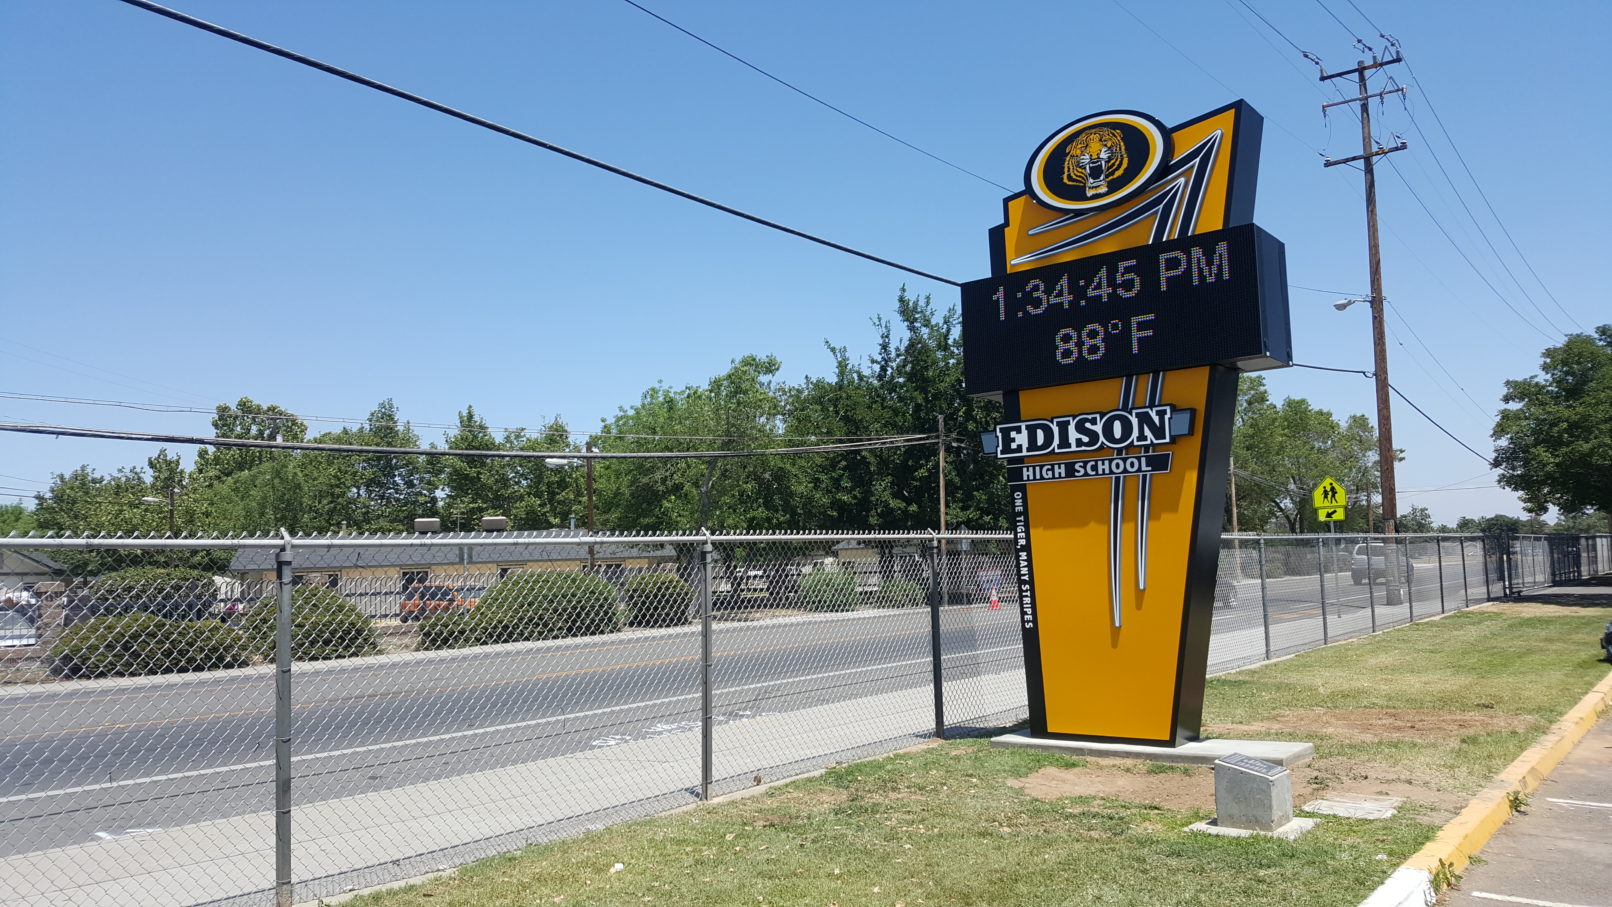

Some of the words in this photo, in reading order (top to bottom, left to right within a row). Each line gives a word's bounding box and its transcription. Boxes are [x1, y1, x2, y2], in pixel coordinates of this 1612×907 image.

[992, 259, 1141, 321] 1:34:45
[1159, 240, 1230, 292] PM
[1130, 313, 1156, 354] F
[996, 405, 1172, 459] EDISON
[1022, 465, 1067, 481] HIGH
[1074, 457, 1153, 477] SCHOOL
[1014, 491, 1024, 512] ONE
[1019, 551, 1030, 581] MANY
[1021, 584, 1034, 629] STRIPES
